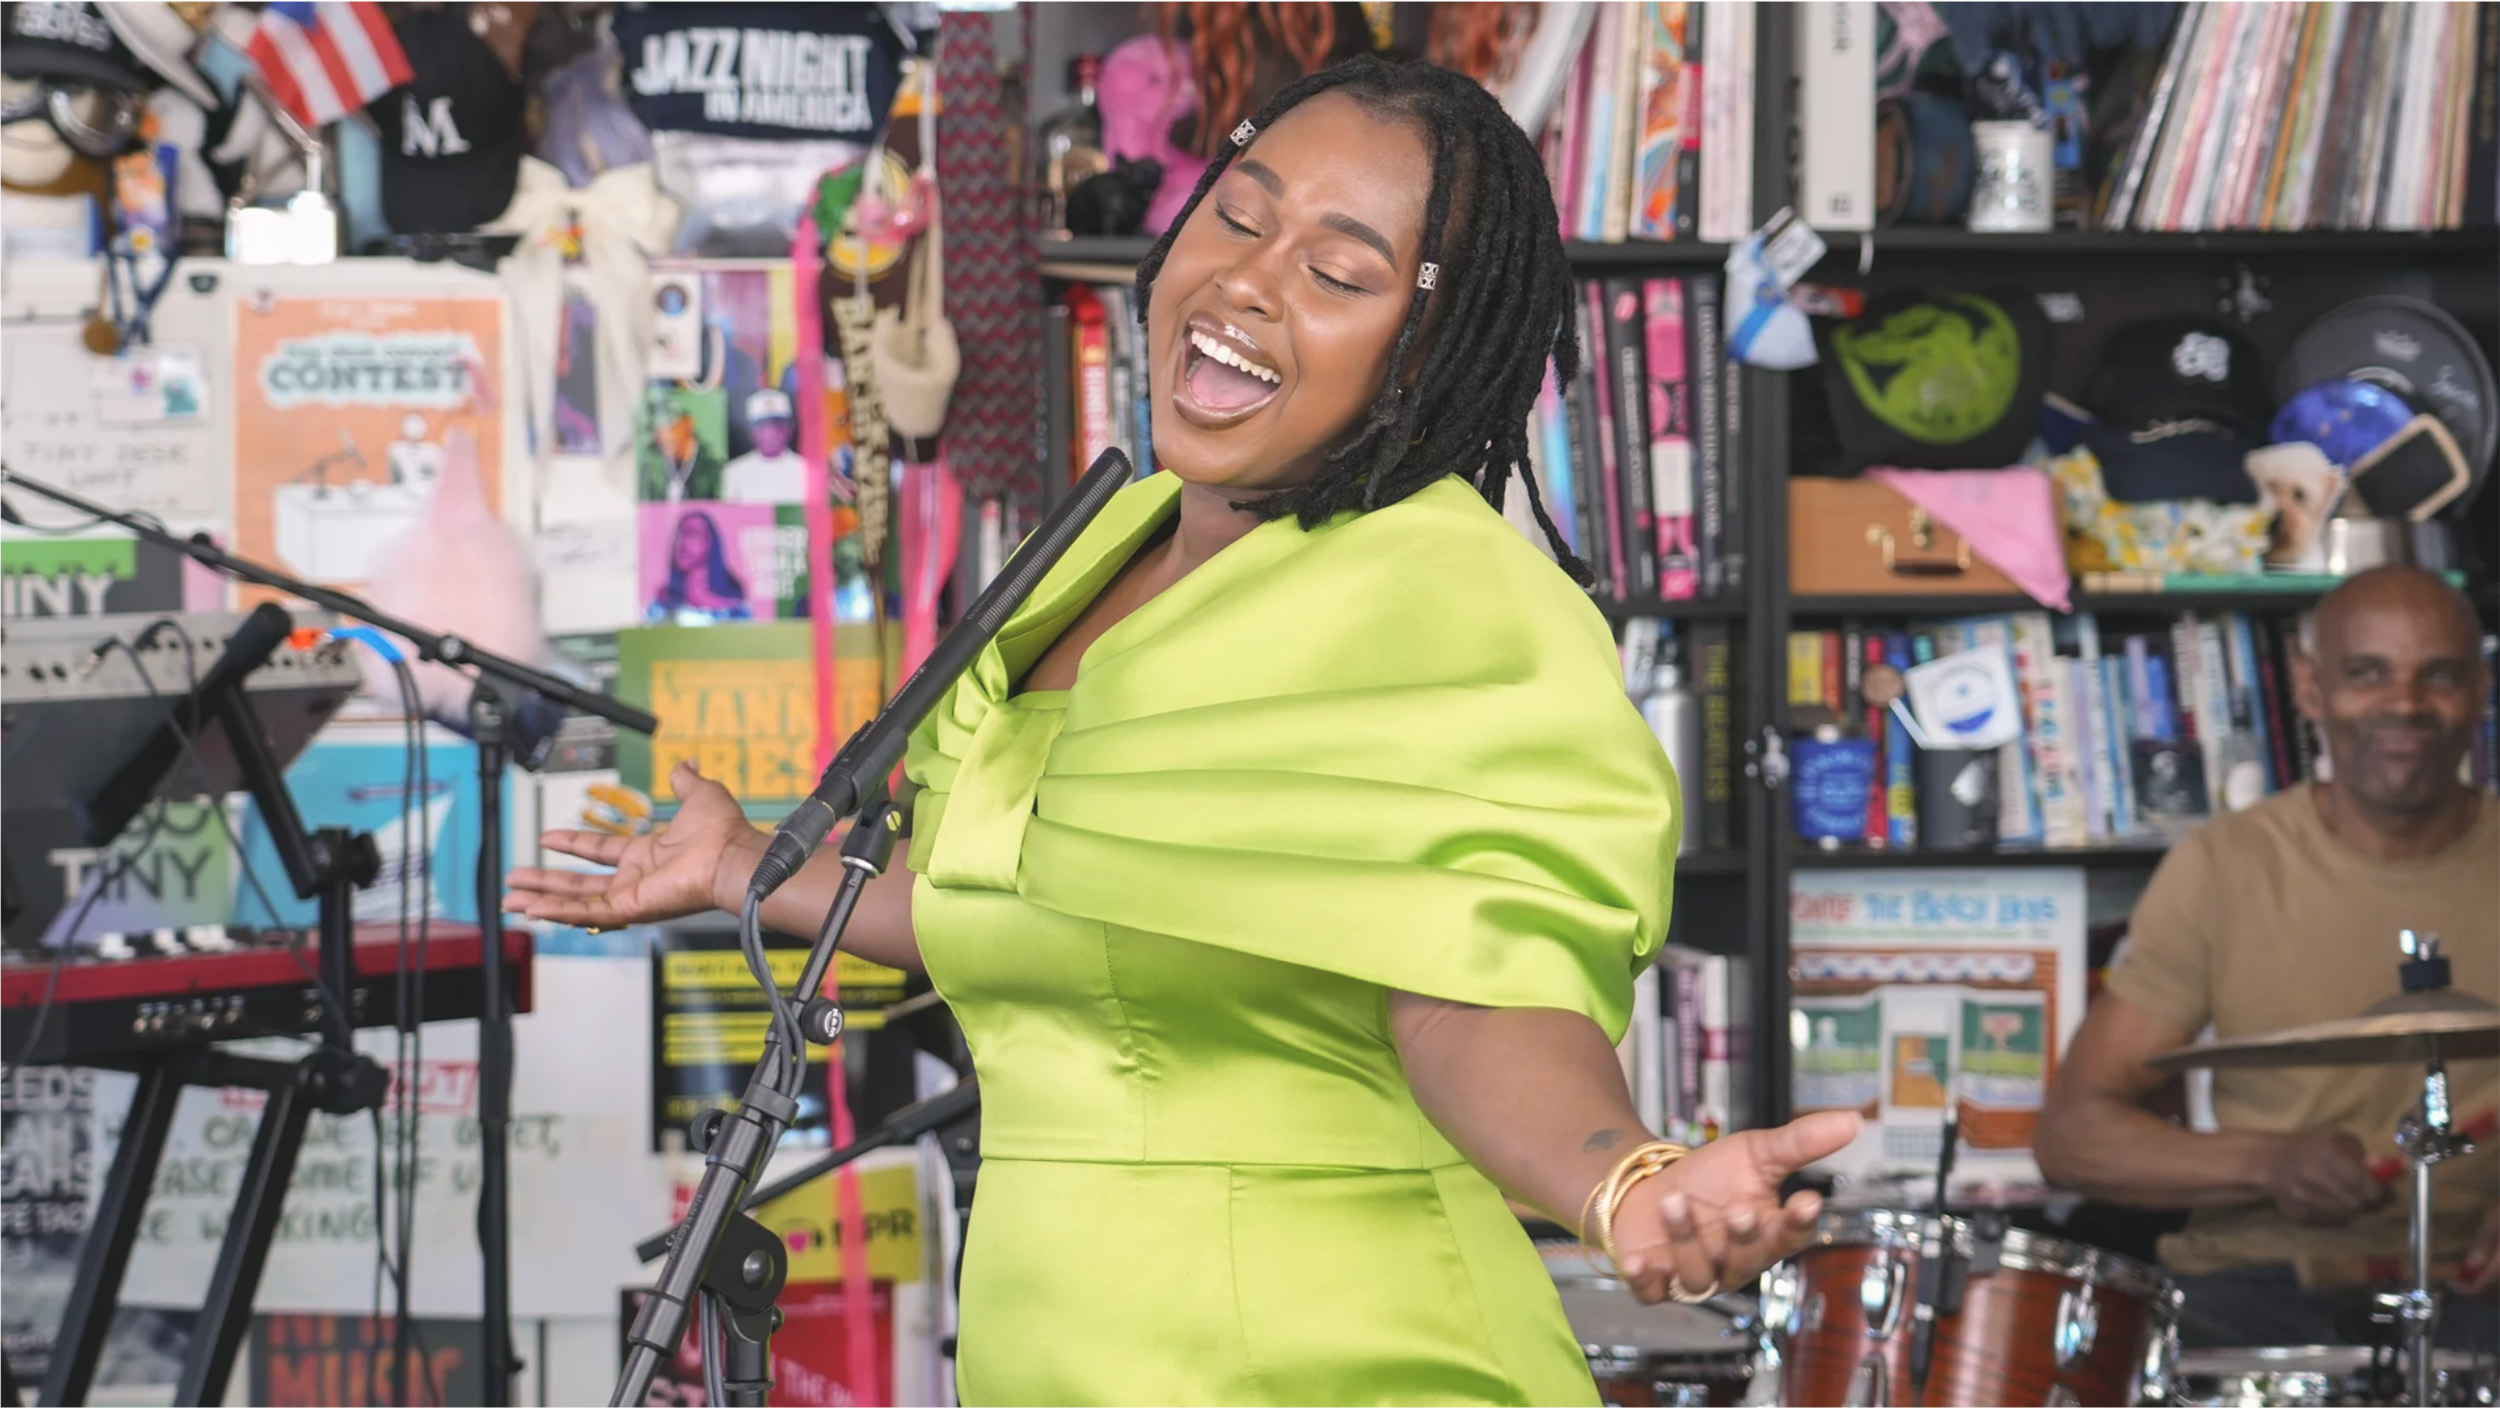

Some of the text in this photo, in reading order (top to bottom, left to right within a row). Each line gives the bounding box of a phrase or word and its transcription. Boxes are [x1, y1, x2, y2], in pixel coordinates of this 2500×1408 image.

[631, 27, 872, 96] JAZZ NIGHT
[401, 93, 472, 158] M
[704, 89, 873, 131] IN AMERICA
[268, 360, 467, 393] CONTEST
